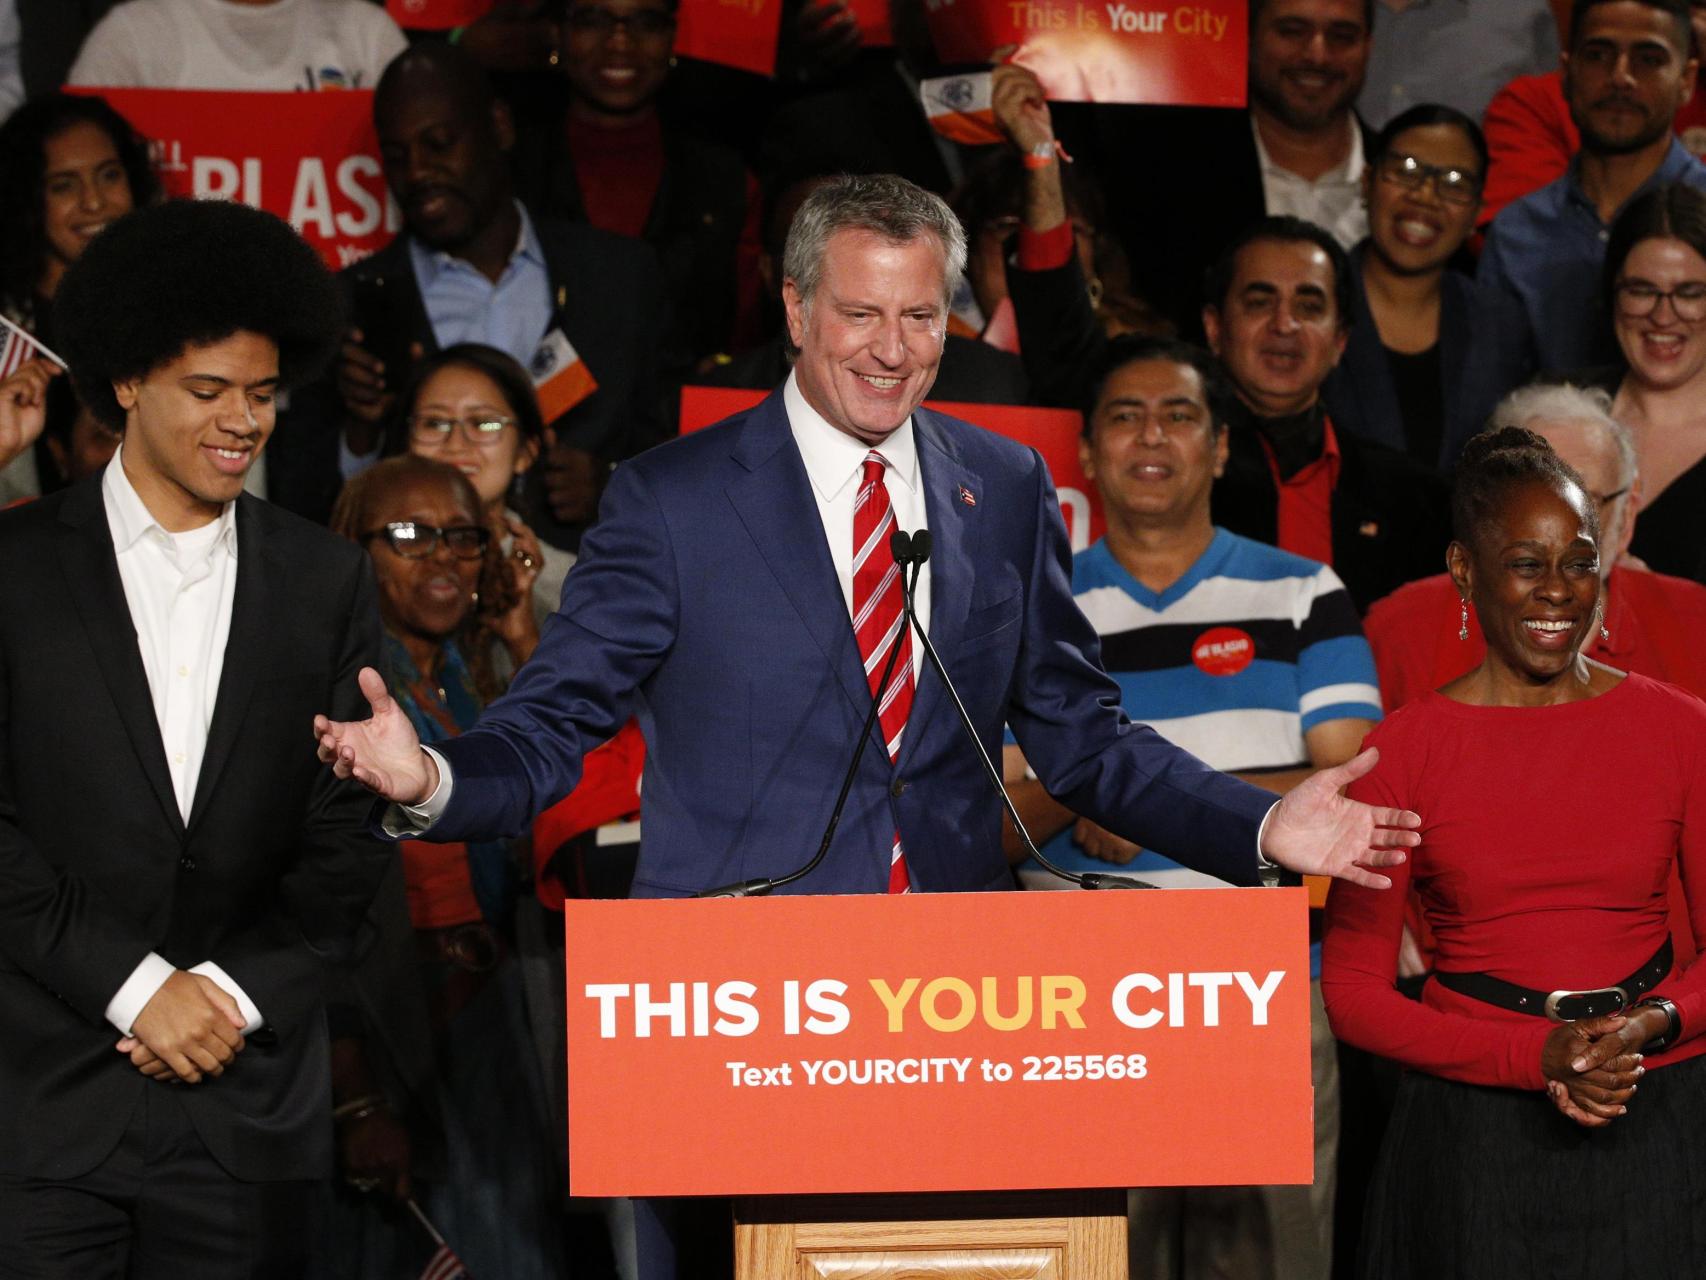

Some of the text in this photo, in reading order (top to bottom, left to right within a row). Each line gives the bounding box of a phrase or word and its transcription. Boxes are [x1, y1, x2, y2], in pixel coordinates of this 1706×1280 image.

[1008, 1, 1229, 42] This Is Your City
[585, 971, 1286, 1038] THIS IS YOUR CITY
[726, 1054, 1148, 1087] Text YOURCITY to 225568
